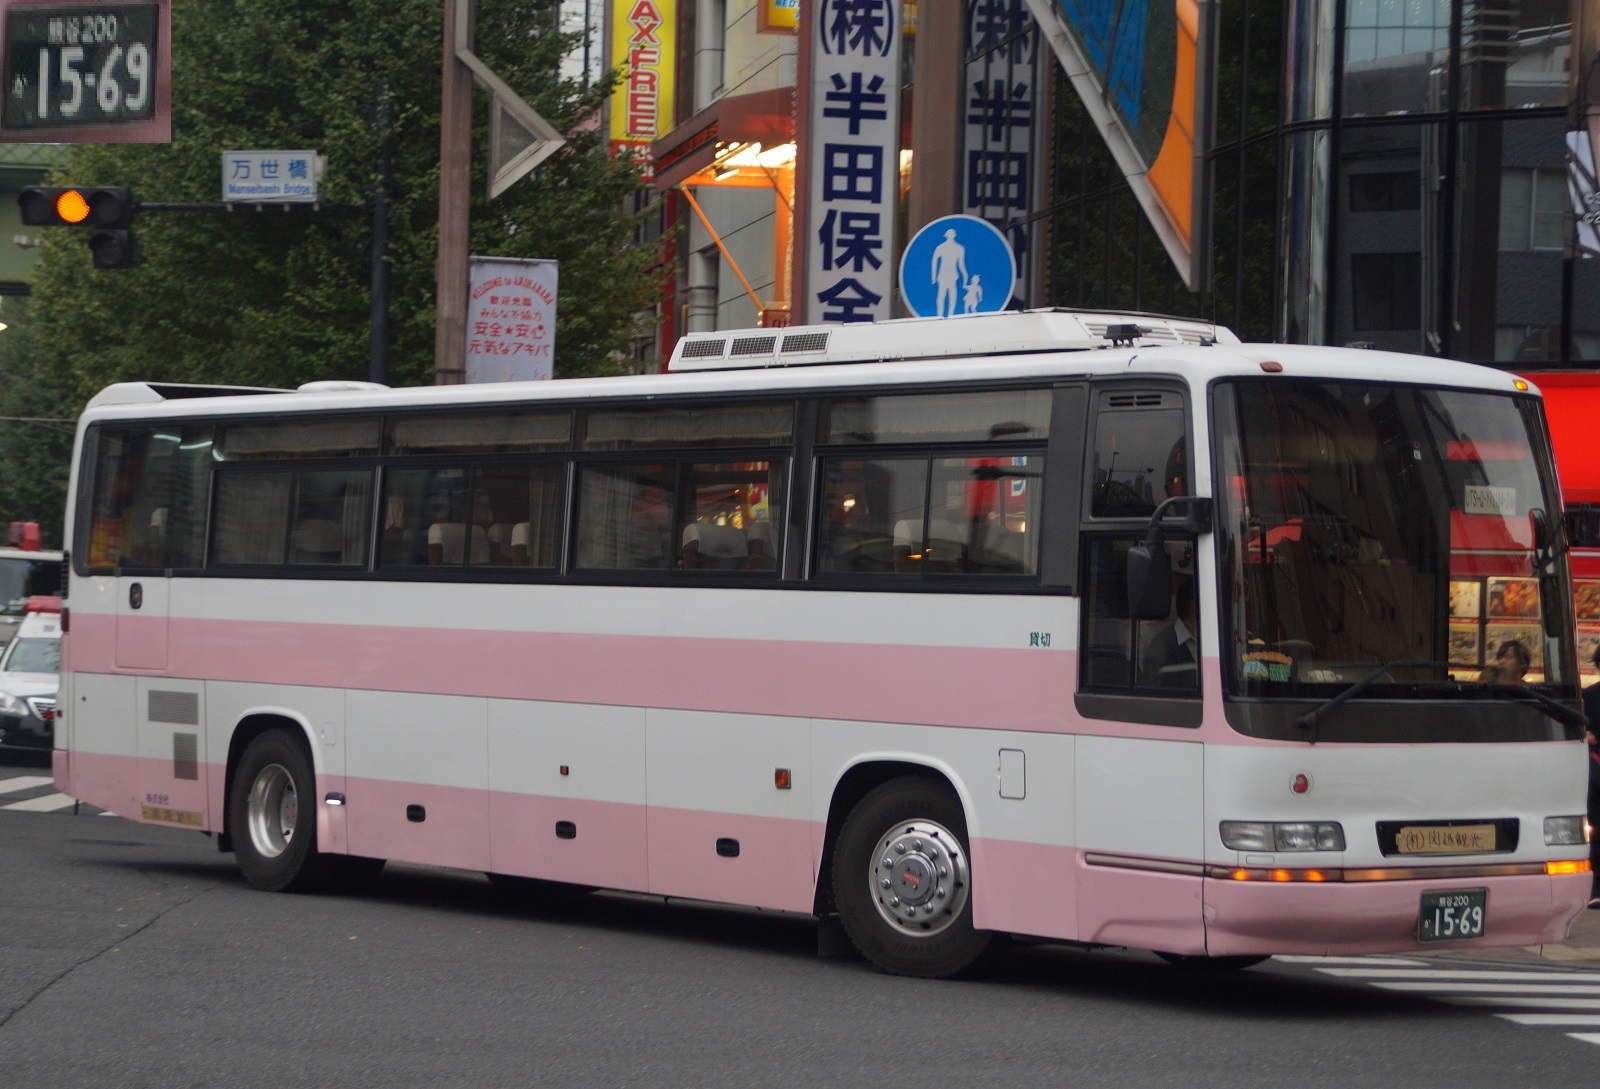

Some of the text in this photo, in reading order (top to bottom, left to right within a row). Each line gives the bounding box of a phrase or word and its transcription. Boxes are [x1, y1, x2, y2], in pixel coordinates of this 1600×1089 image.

[627, 47, 660, 138] FREE
[231, 159, 309, 179] 万世橋
[228, 183, 311, 195] Manseibashi Bridge
[471, 276, 502, 300] WELCOME
[513, 276, 554, 306] AKIHABARA
[480, 307, 542, 321] みんなで協力
[468, 340, 551, 357] 元気なアキバ
[1029, 631, 1051, 647] 貸切
[1434, 906, 1482, 937] 15-69
